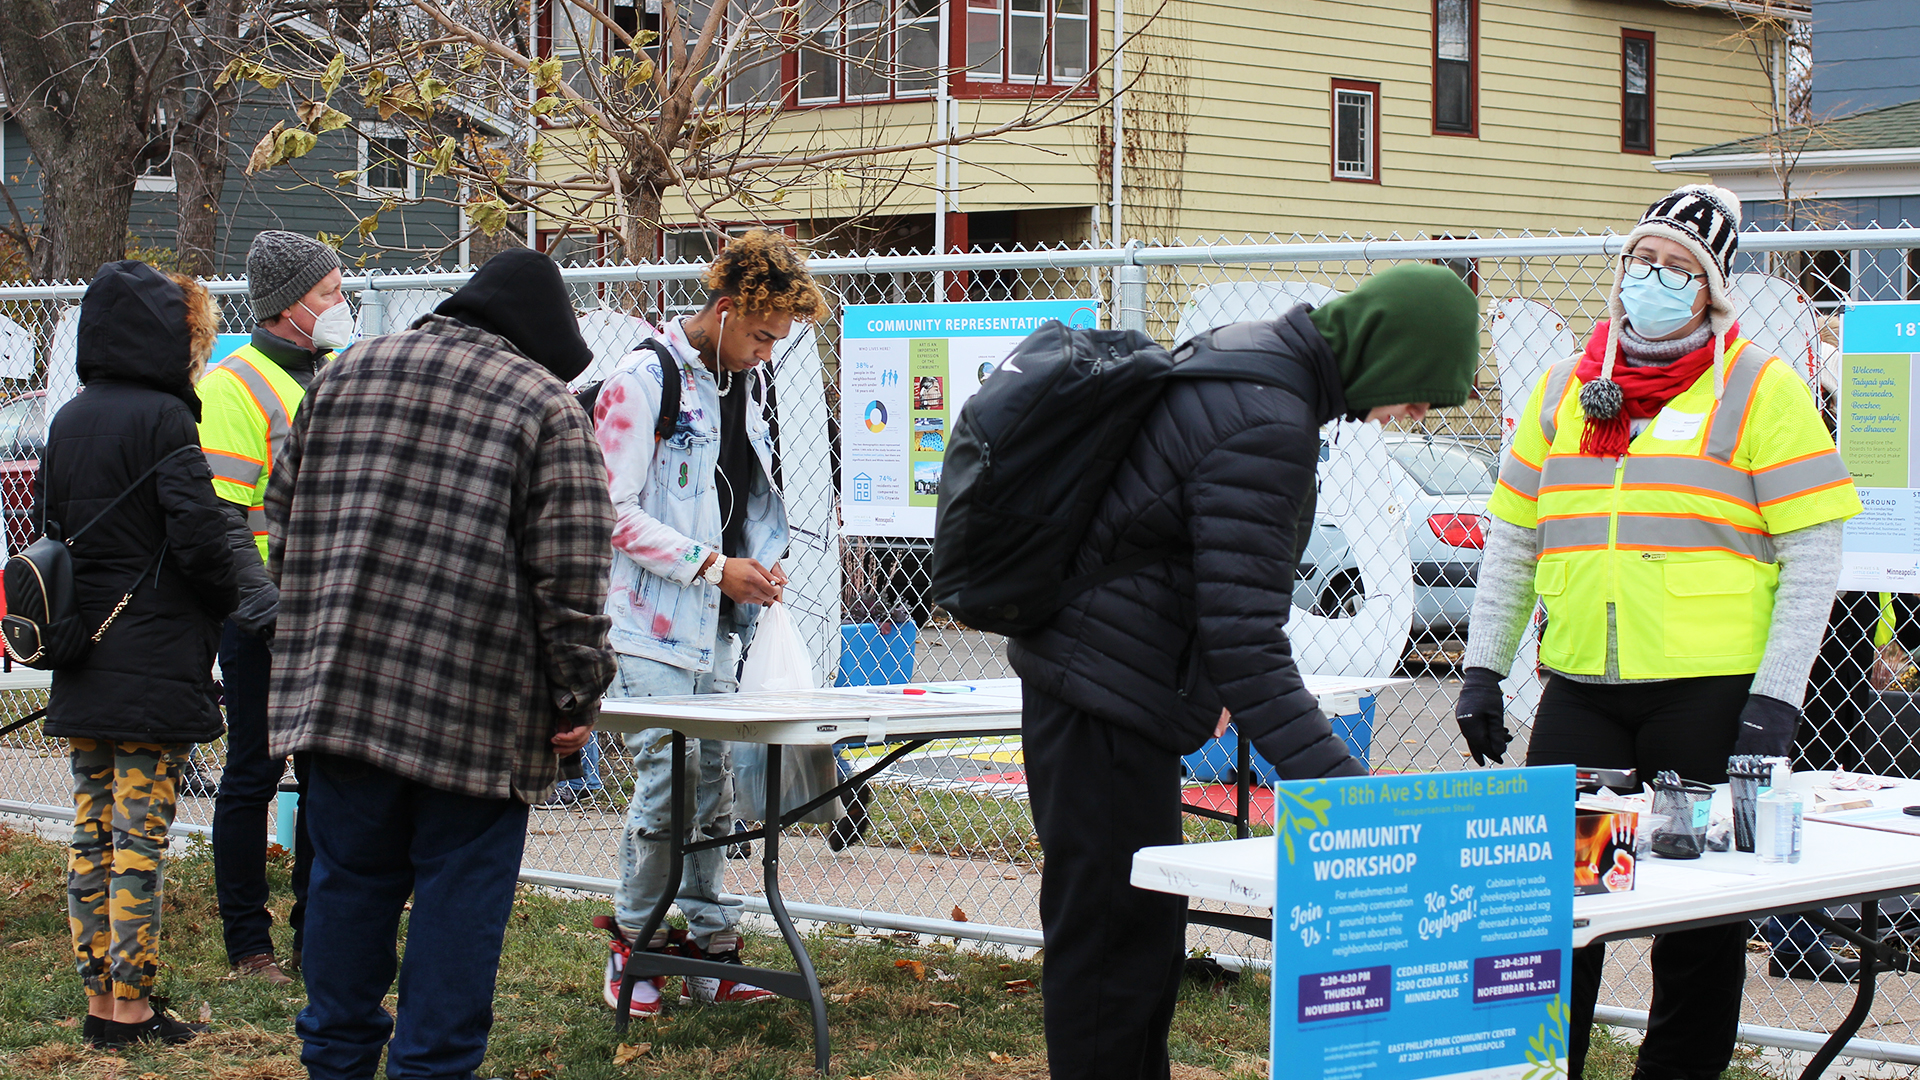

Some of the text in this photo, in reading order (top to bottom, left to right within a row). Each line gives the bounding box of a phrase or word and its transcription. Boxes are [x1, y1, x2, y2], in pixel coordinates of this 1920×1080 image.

[867, 316, 1060, 332] COMMUNITY REPRESENTATIO
[1852, 366, 1885, 374] Welcome,
[1850, 425, 1862, 433] Soo
[1886, 568, 1916, 576] Minneapolis
[1339, 773, 1528, 806] 18th Ave S & Little Earth
[1394, 804, 1475, 816] Transportation Study
[1466, 814, 1548, 839] KULANKA
[1309, 824, 1422, 852] COMMUNITY
[1460, 841, 1553, 868] BULSHADA
[1313, 852, 1417, 881] WORKSHOP
[1486, 874, 1546, 888] Cabitaan iyo wada
[1335, 883, 1408, 900] For refreshments and
[1424, 884, 1476, 913] Ka Soo
[1480, 887, 1551, 902] sheekeysiga bulshada
[1328, 898, 1414, 914] community conversation
[1480, 908, 1488, 916] ee
[1490, 904, 1513, 915] bonfire
[1524, 902, 1537, 911] aad
[1538, 902, 1551, 911] xog
[1290, 902, 1324, 931] Join
[1339, 911, 1403, 928] around the bonfire
[1478, 915, 1552, 930] dheeraad ah ka ogaato
[1301, 926, 1321, 948] Us
[1339, 926, 1402, 941] to learn about this
[1481, 927, 1548, 942] mashruuca xaafadda
[1332, 939, 1408, 957] neighborhood project
[1396, 960, 1469, 978] CEDAR FIELD PARK
[1493, 955, 1542, 969] 2:30-4:30 PM
[1320, 971, 1371, 987] 2:30-4:30 PM
[1395, 973, 1469, 991] 2500 CEDAR AVE. S
[1501, 969, 1534, 981] KHAMIIS
[1324, 986, 1367, 1000] THURSDAY
[1405, 987, 1459, 1004] MINNEAPOLIS
[1477, 980, 1556, 998] NOFEEMBAR 18, 2021
[1305, 997, 1384, 1017] NOVEMBER 18, 2021
[1388, 1043, 1405, 1054] EAST
[1405, 1039, 1433, 1051] PHILLIPS
[1434, 1037, 1451, 1048] PARK
[1451, 1032, 1491, 1044] COMMUNITY
[1492, 1028, 1517, 1039] CENTER
[1398, 1040, 1506, 1063] AT 2307 17TH AVE S, MINNEAPOLIS
